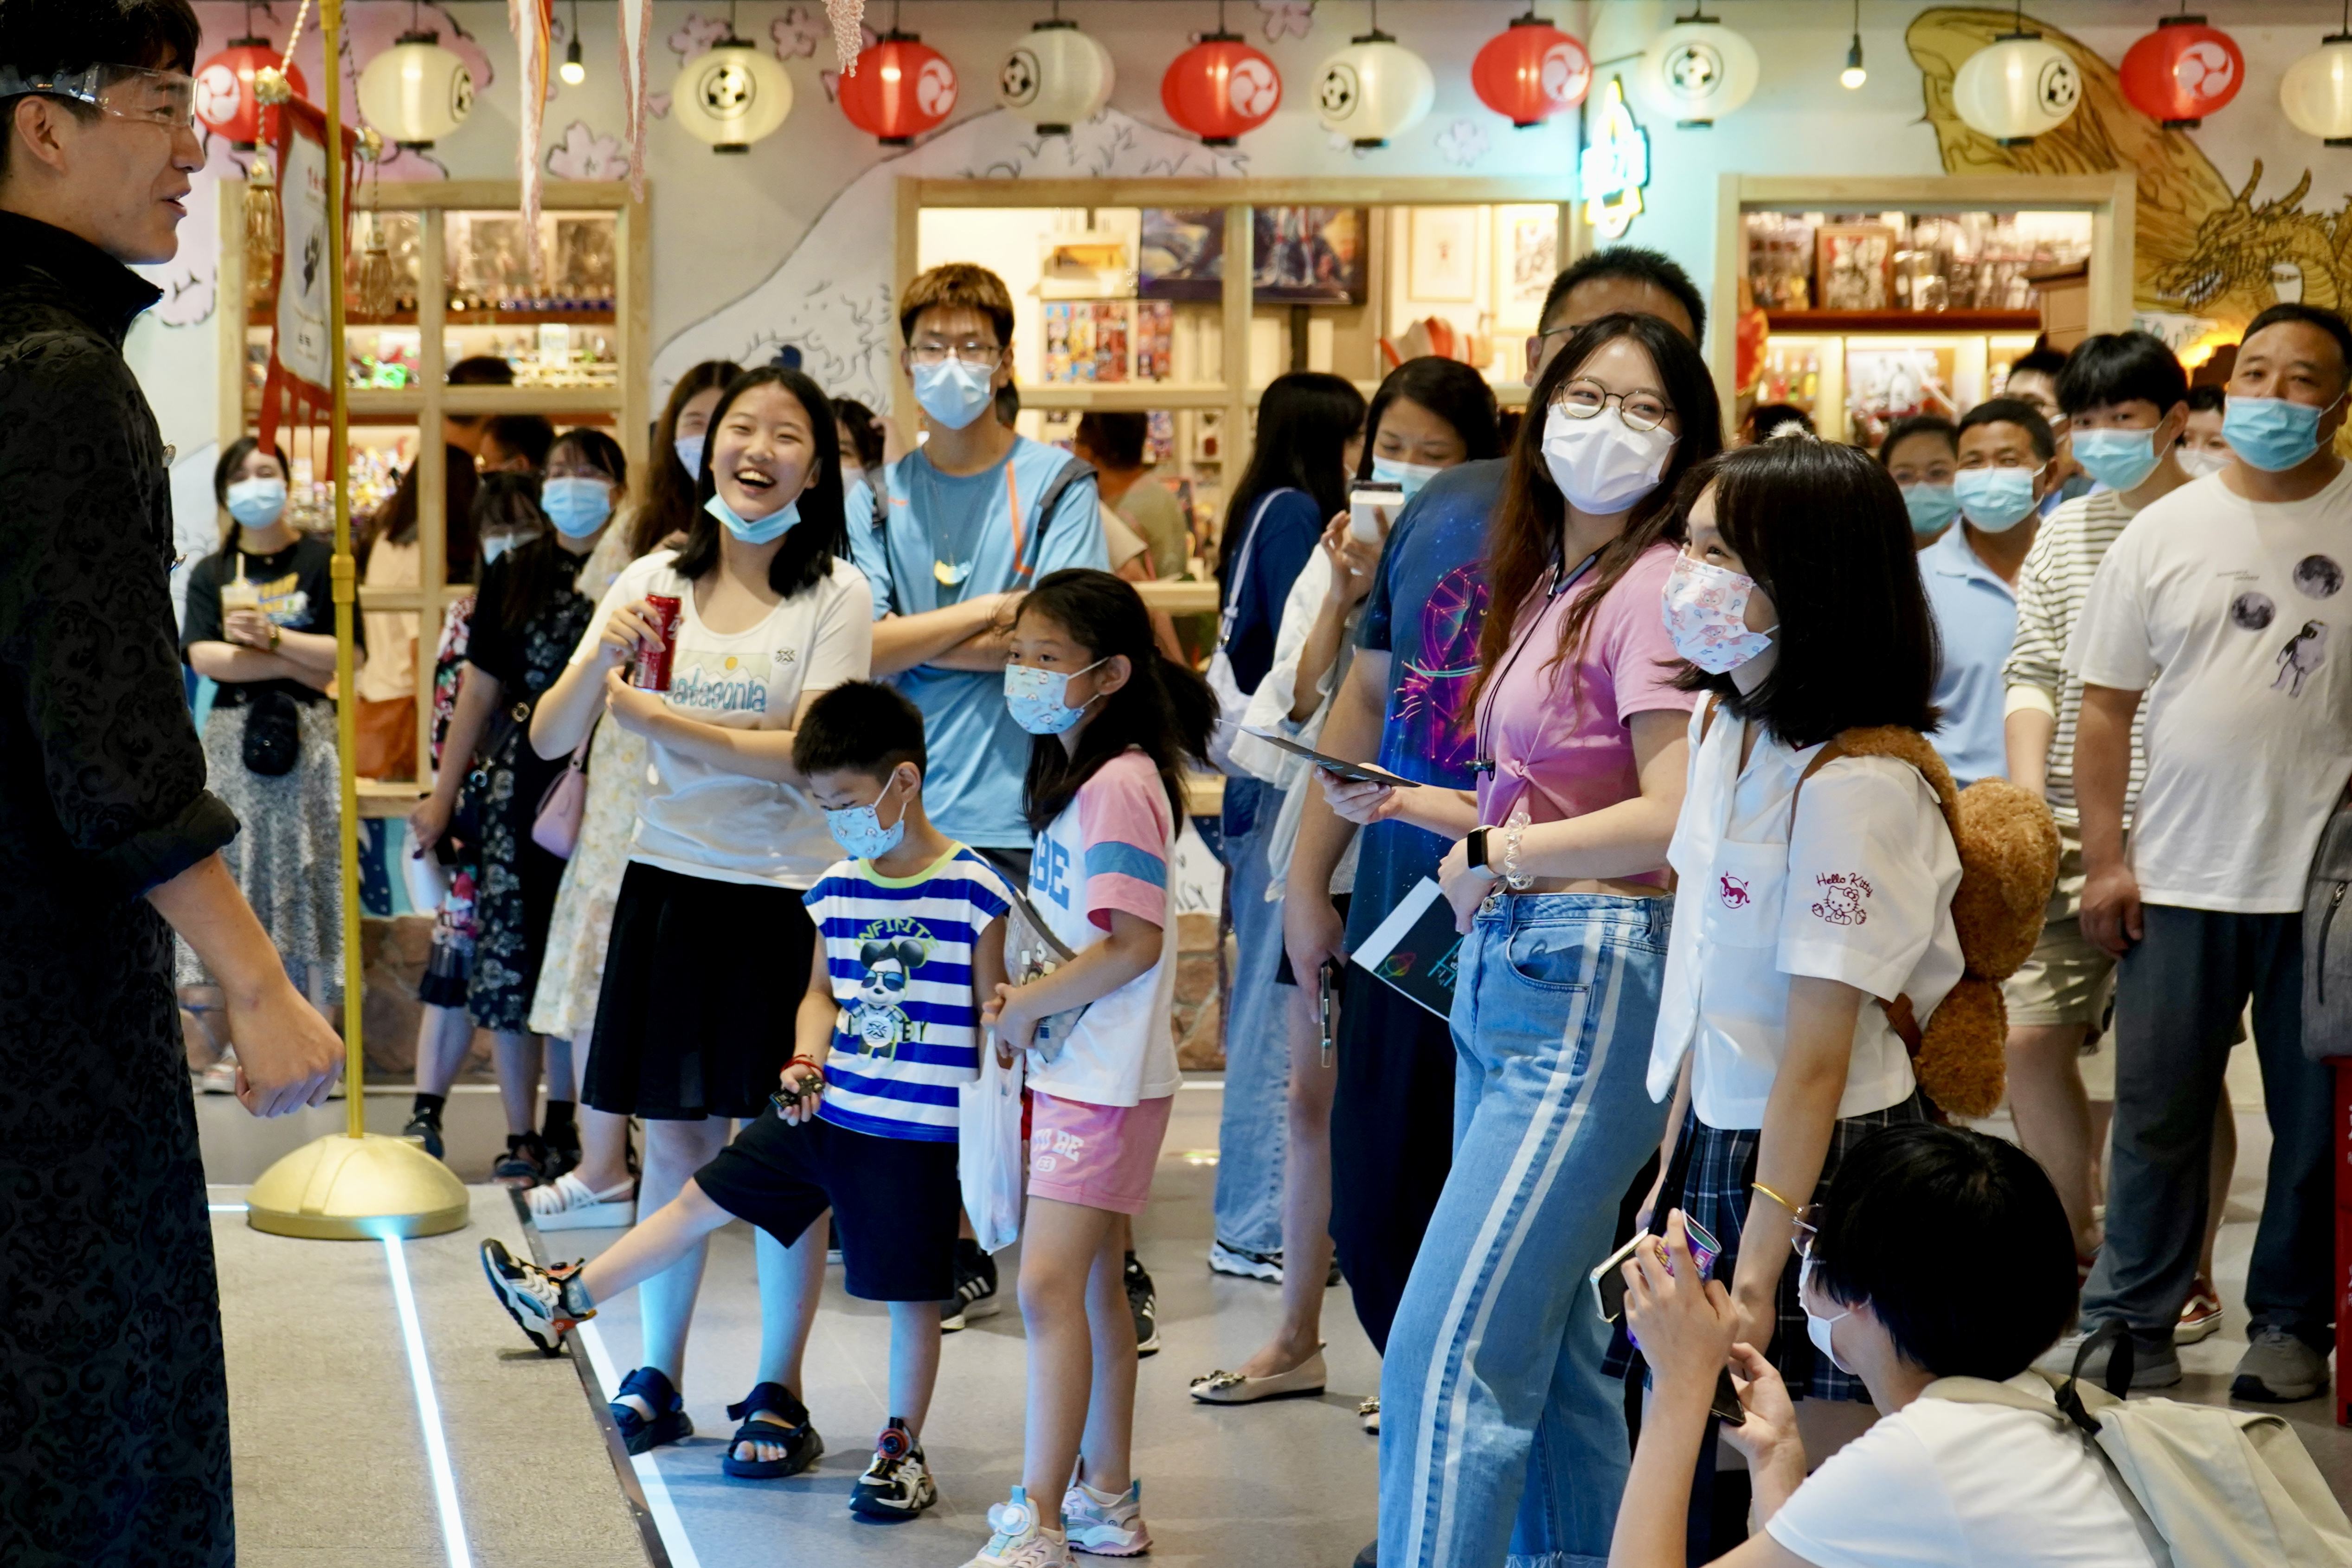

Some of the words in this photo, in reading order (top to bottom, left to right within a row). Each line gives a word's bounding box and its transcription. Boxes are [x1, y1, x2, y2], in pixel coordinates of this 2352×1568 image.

[1817, 872, 1846, 887] Hello
[1849, 873, 1873, 898] Kitty
[854, 916, 940, 952] INFINITE
[1052, 1130, 1084, 1162] BE
